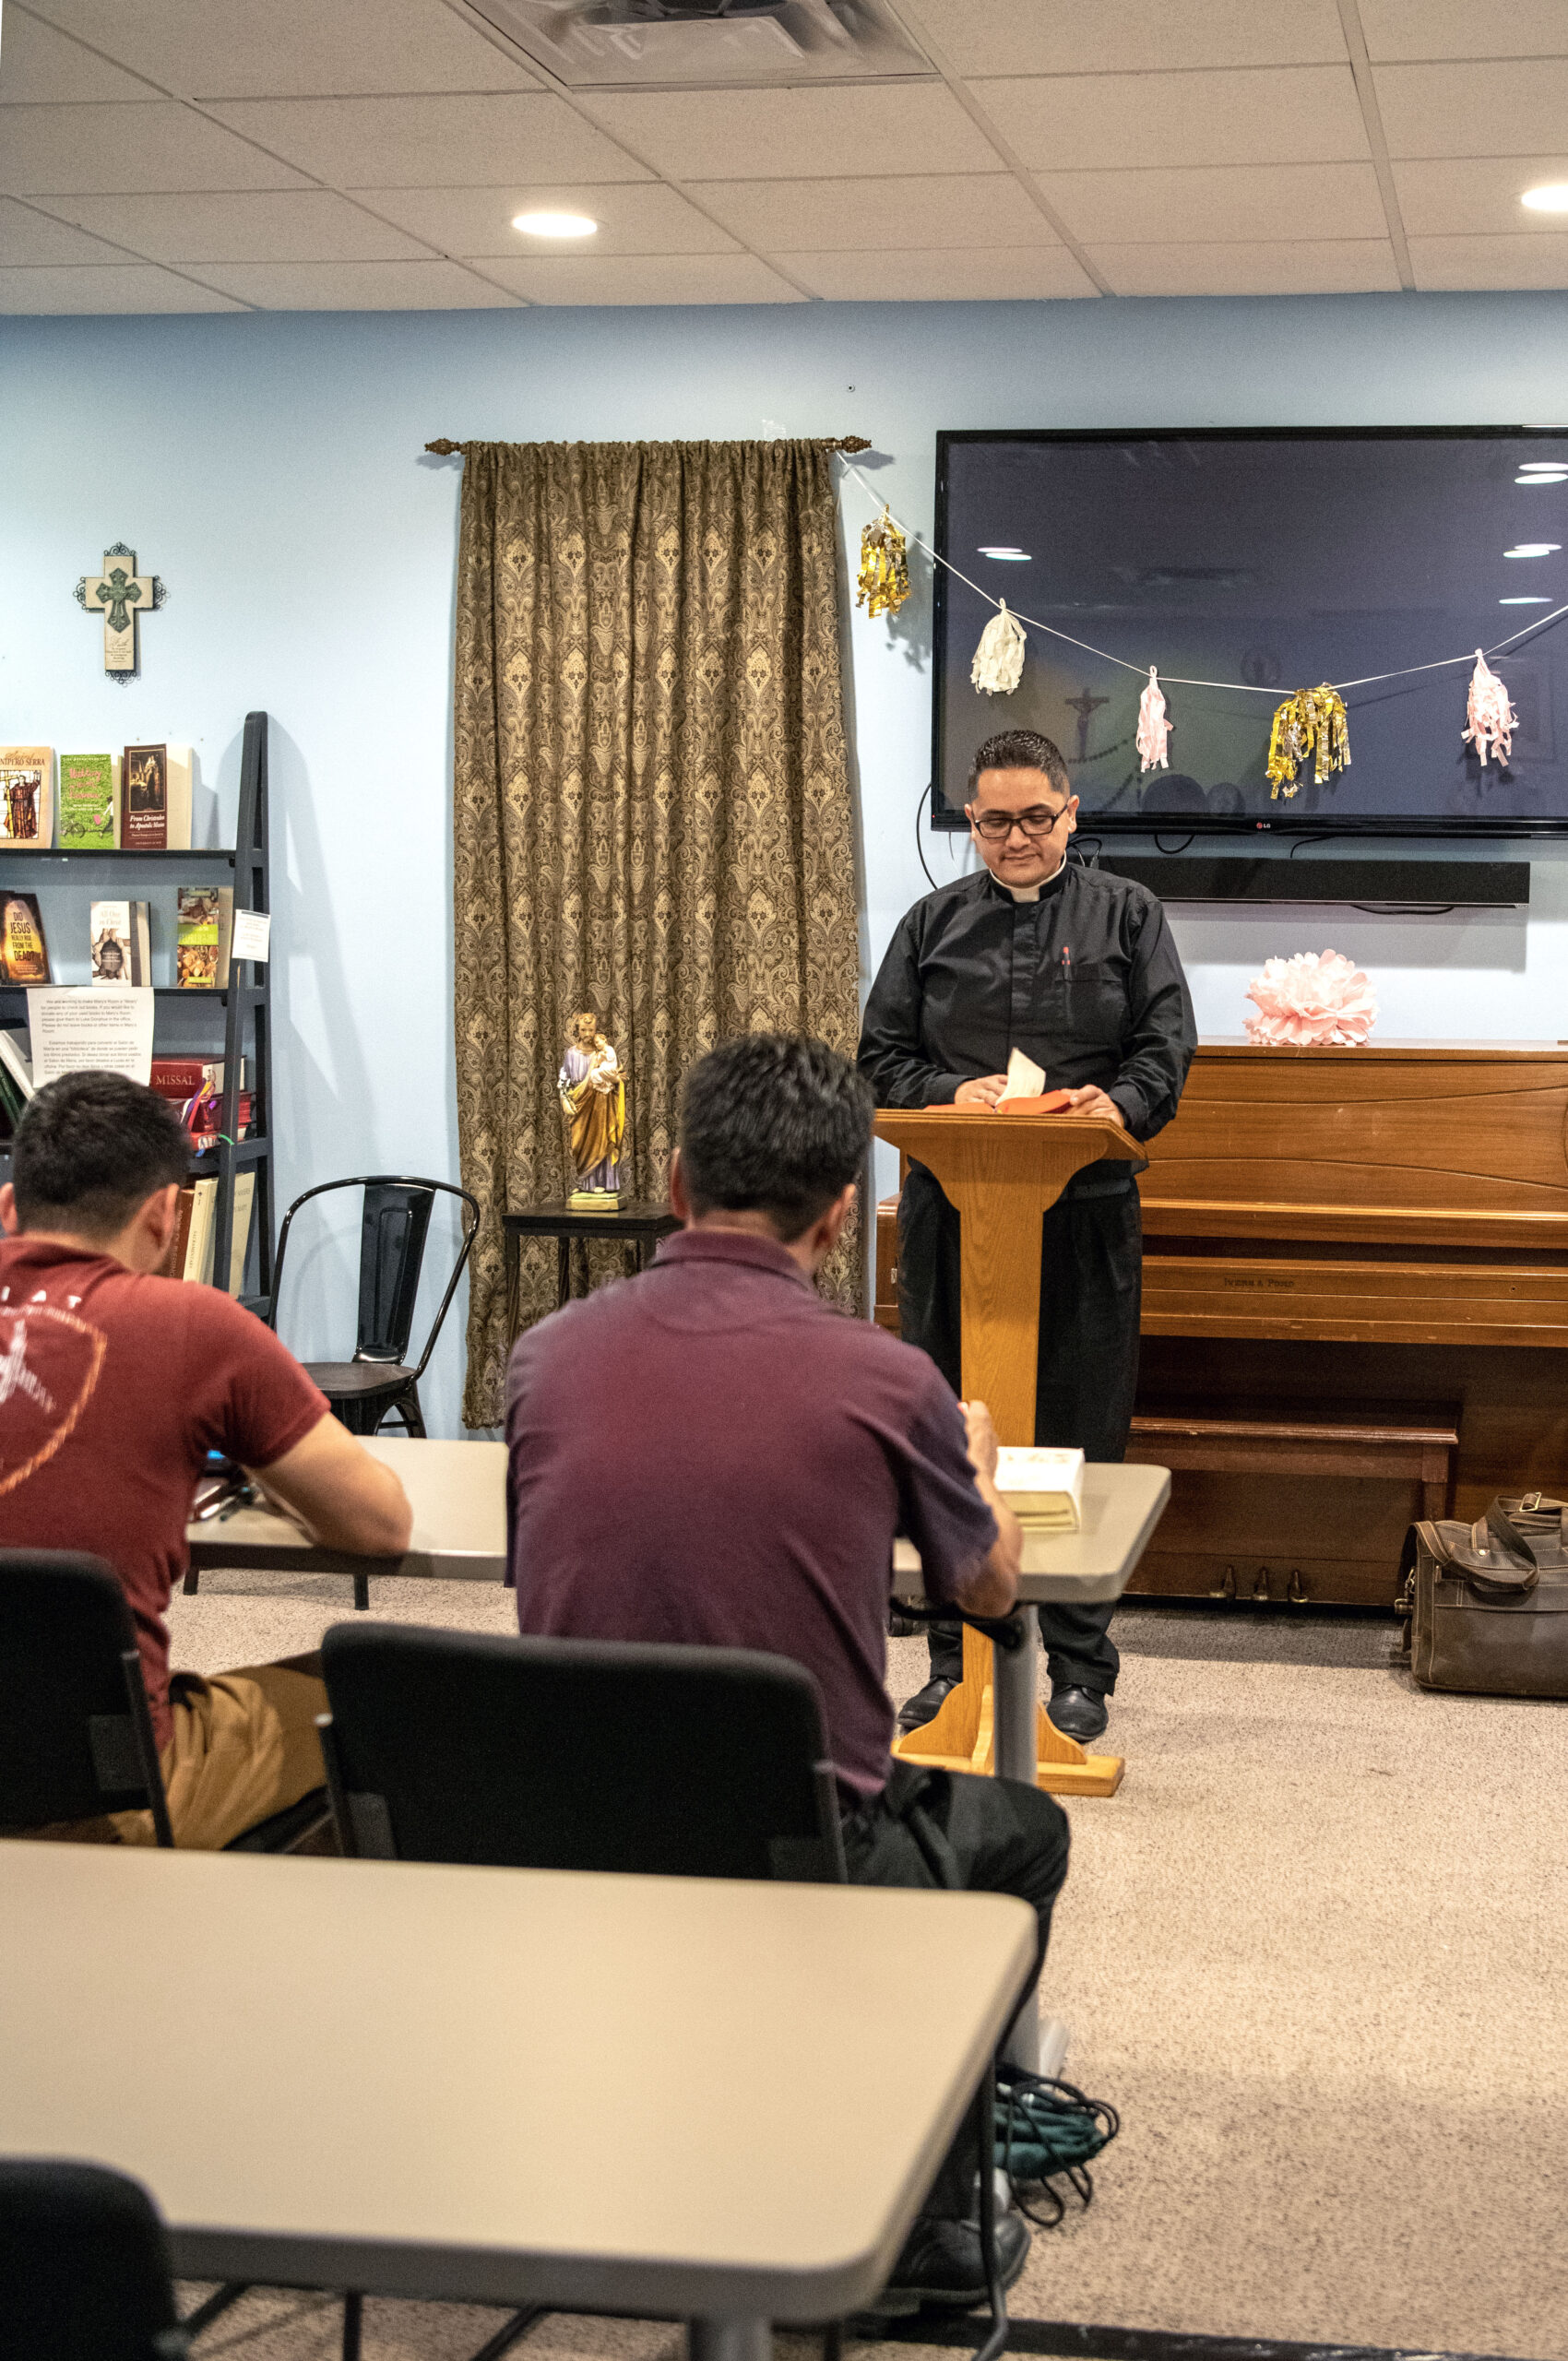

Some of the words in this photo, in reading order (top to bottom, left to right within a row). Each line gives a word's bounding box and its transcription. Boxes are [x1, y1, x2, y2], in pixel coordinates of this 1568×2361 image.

[13, 911, 24, 921] DID
[11, 922, 31, 934] JESUS
[25, 941, 34, 949] THE
[155, 1074, 196, 1086] MISSAL
[170, 1245, 179, 1278] BLESSING
